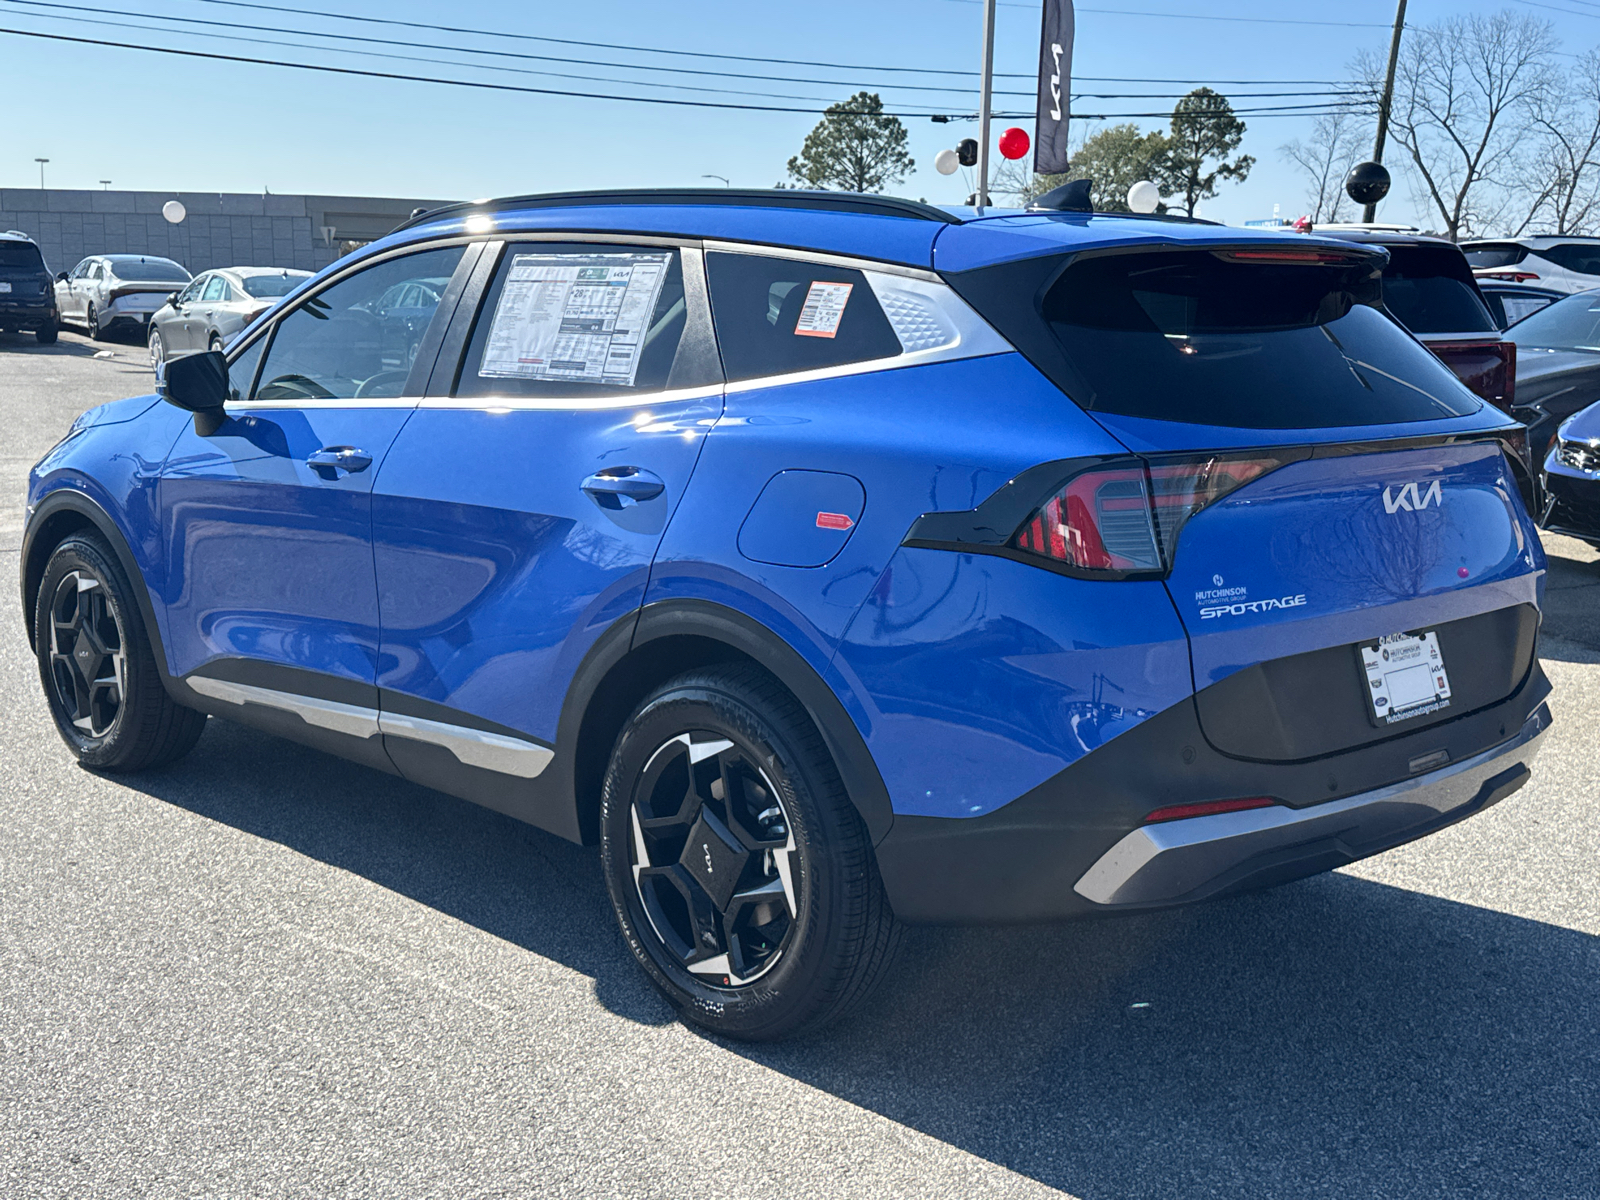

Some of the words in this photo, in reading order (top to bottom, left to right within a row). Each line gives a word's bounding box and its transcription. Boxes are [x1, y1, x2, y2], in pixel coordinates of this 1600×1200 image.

[1050, 43, 1063, 120] KIA
[574, 289, 584, 297] 28
[1382, 480, 1442, 514] KIA
[1195, 587, 1247, 600] HUTCHINSON
[1197, 597, 1230, 606] AUTOMOTIVE
[1199, 594, 1307, 620] SPORTAGE
[1390, 643, 1421, 657] HUTCHINSON
[1431, 664, 1445, 673] KIA
[703, 843, 714, 873] KIA
